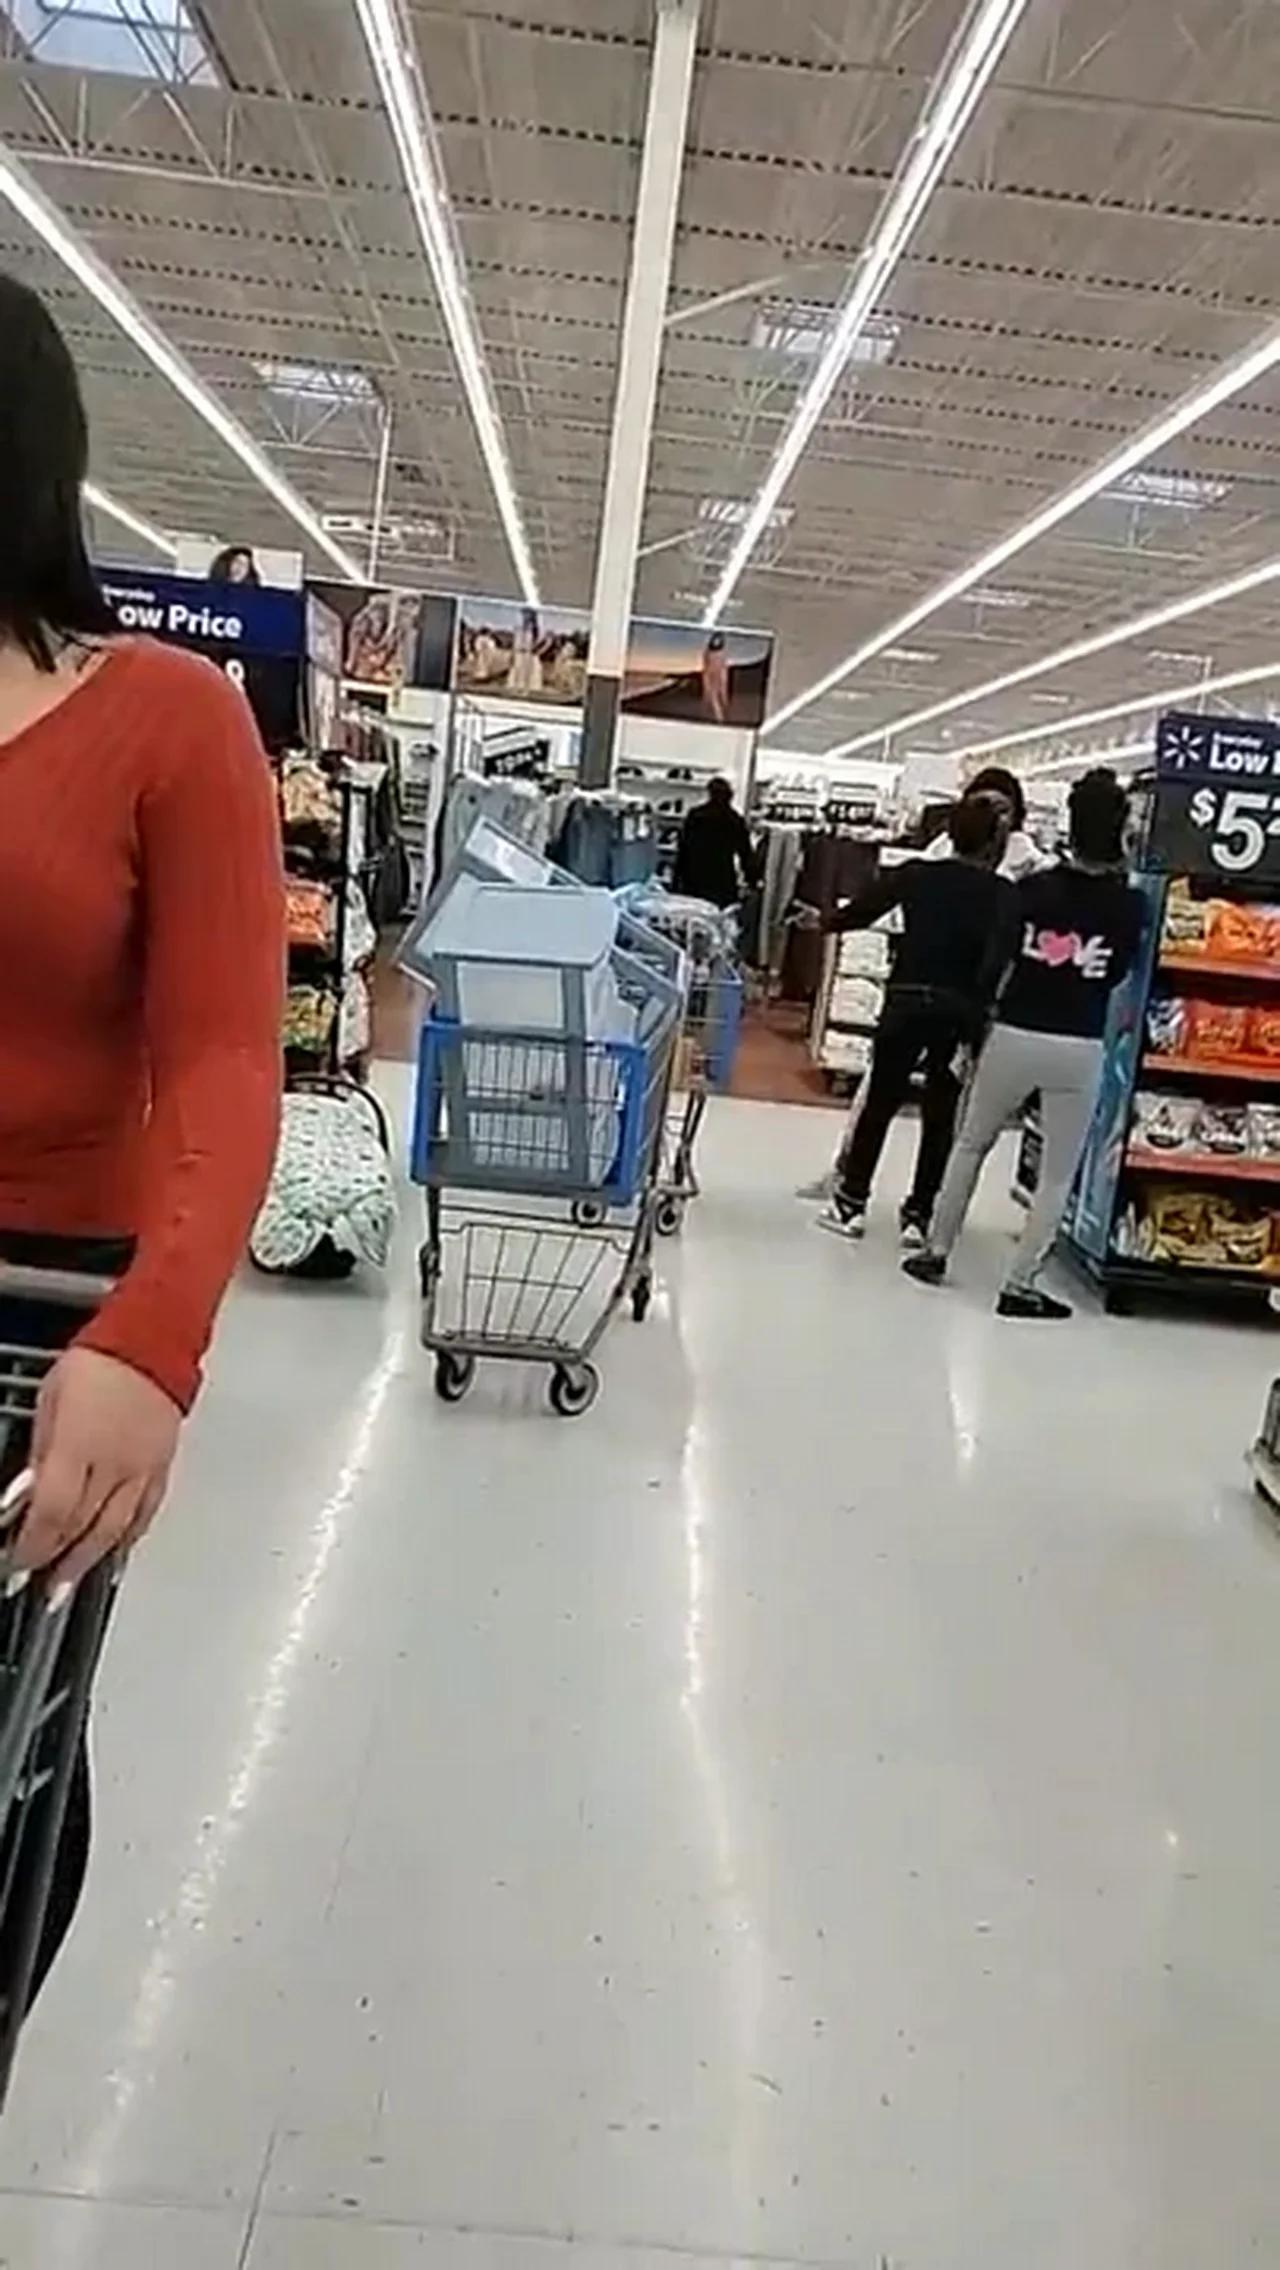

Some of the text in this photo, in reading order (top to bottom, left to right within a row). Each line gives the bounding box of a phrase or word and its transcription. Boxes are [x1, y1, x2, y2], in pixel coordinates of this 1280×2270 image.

[108, 600, 243, 638] ow Price
[1209, 743, 1270, 774] Low
